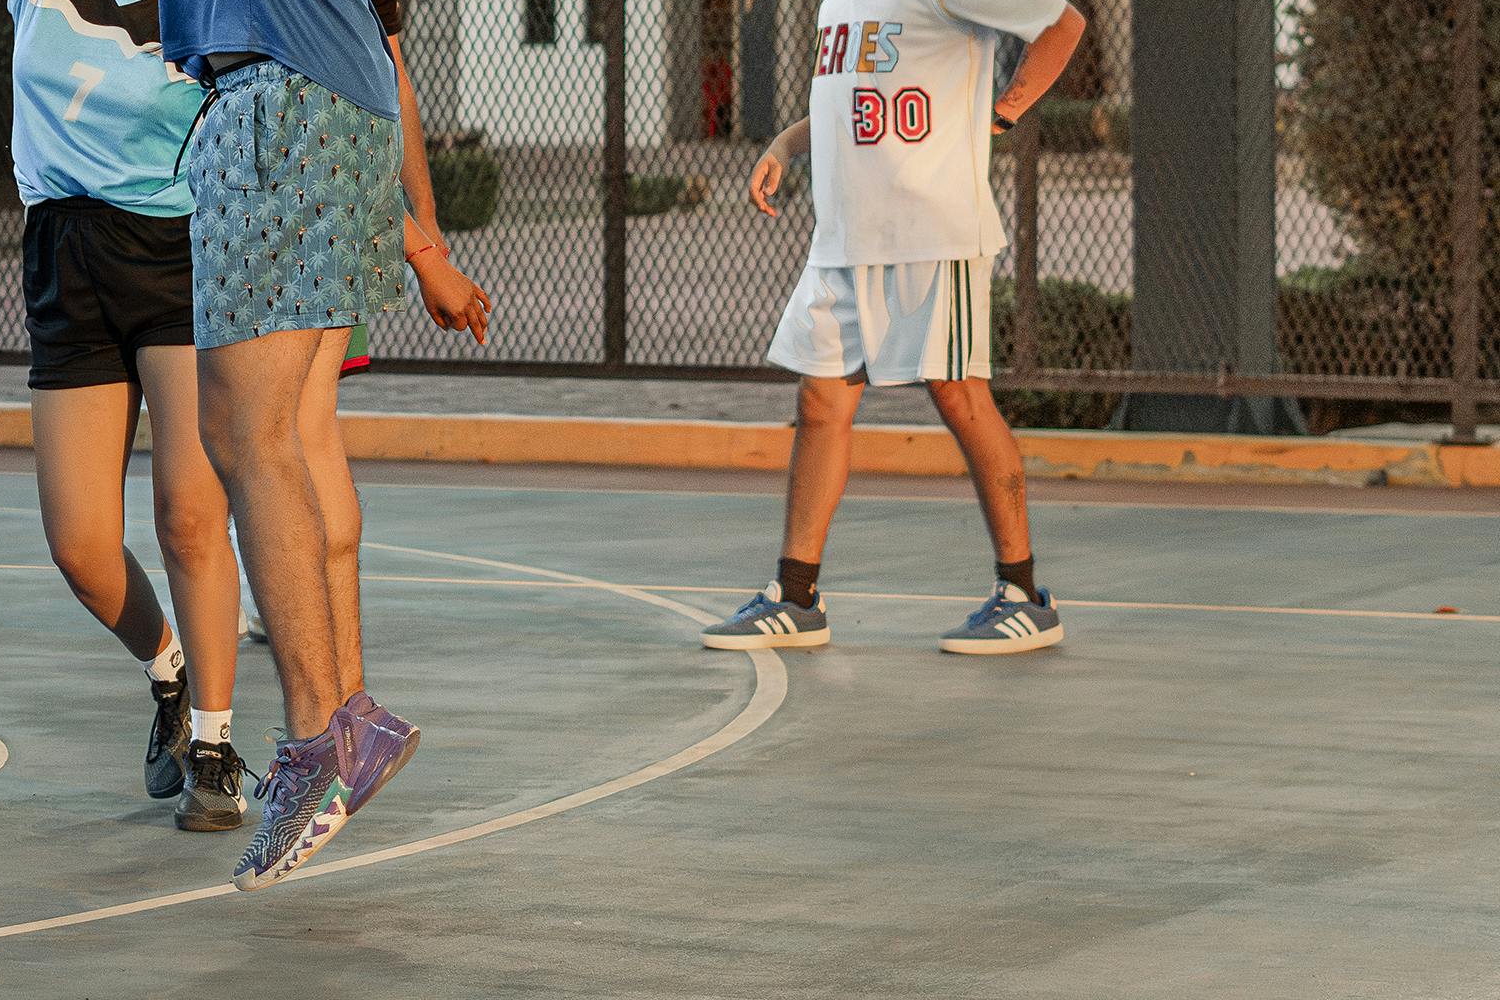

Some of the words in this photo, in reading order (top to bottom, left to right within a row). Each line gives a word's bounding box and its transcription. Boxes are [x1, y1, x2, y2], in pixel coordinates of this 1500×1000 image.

[813, 21, 903, 79] EROES
[64, 61, 105, 121] 7
[852, 86, 931, 145] 30
